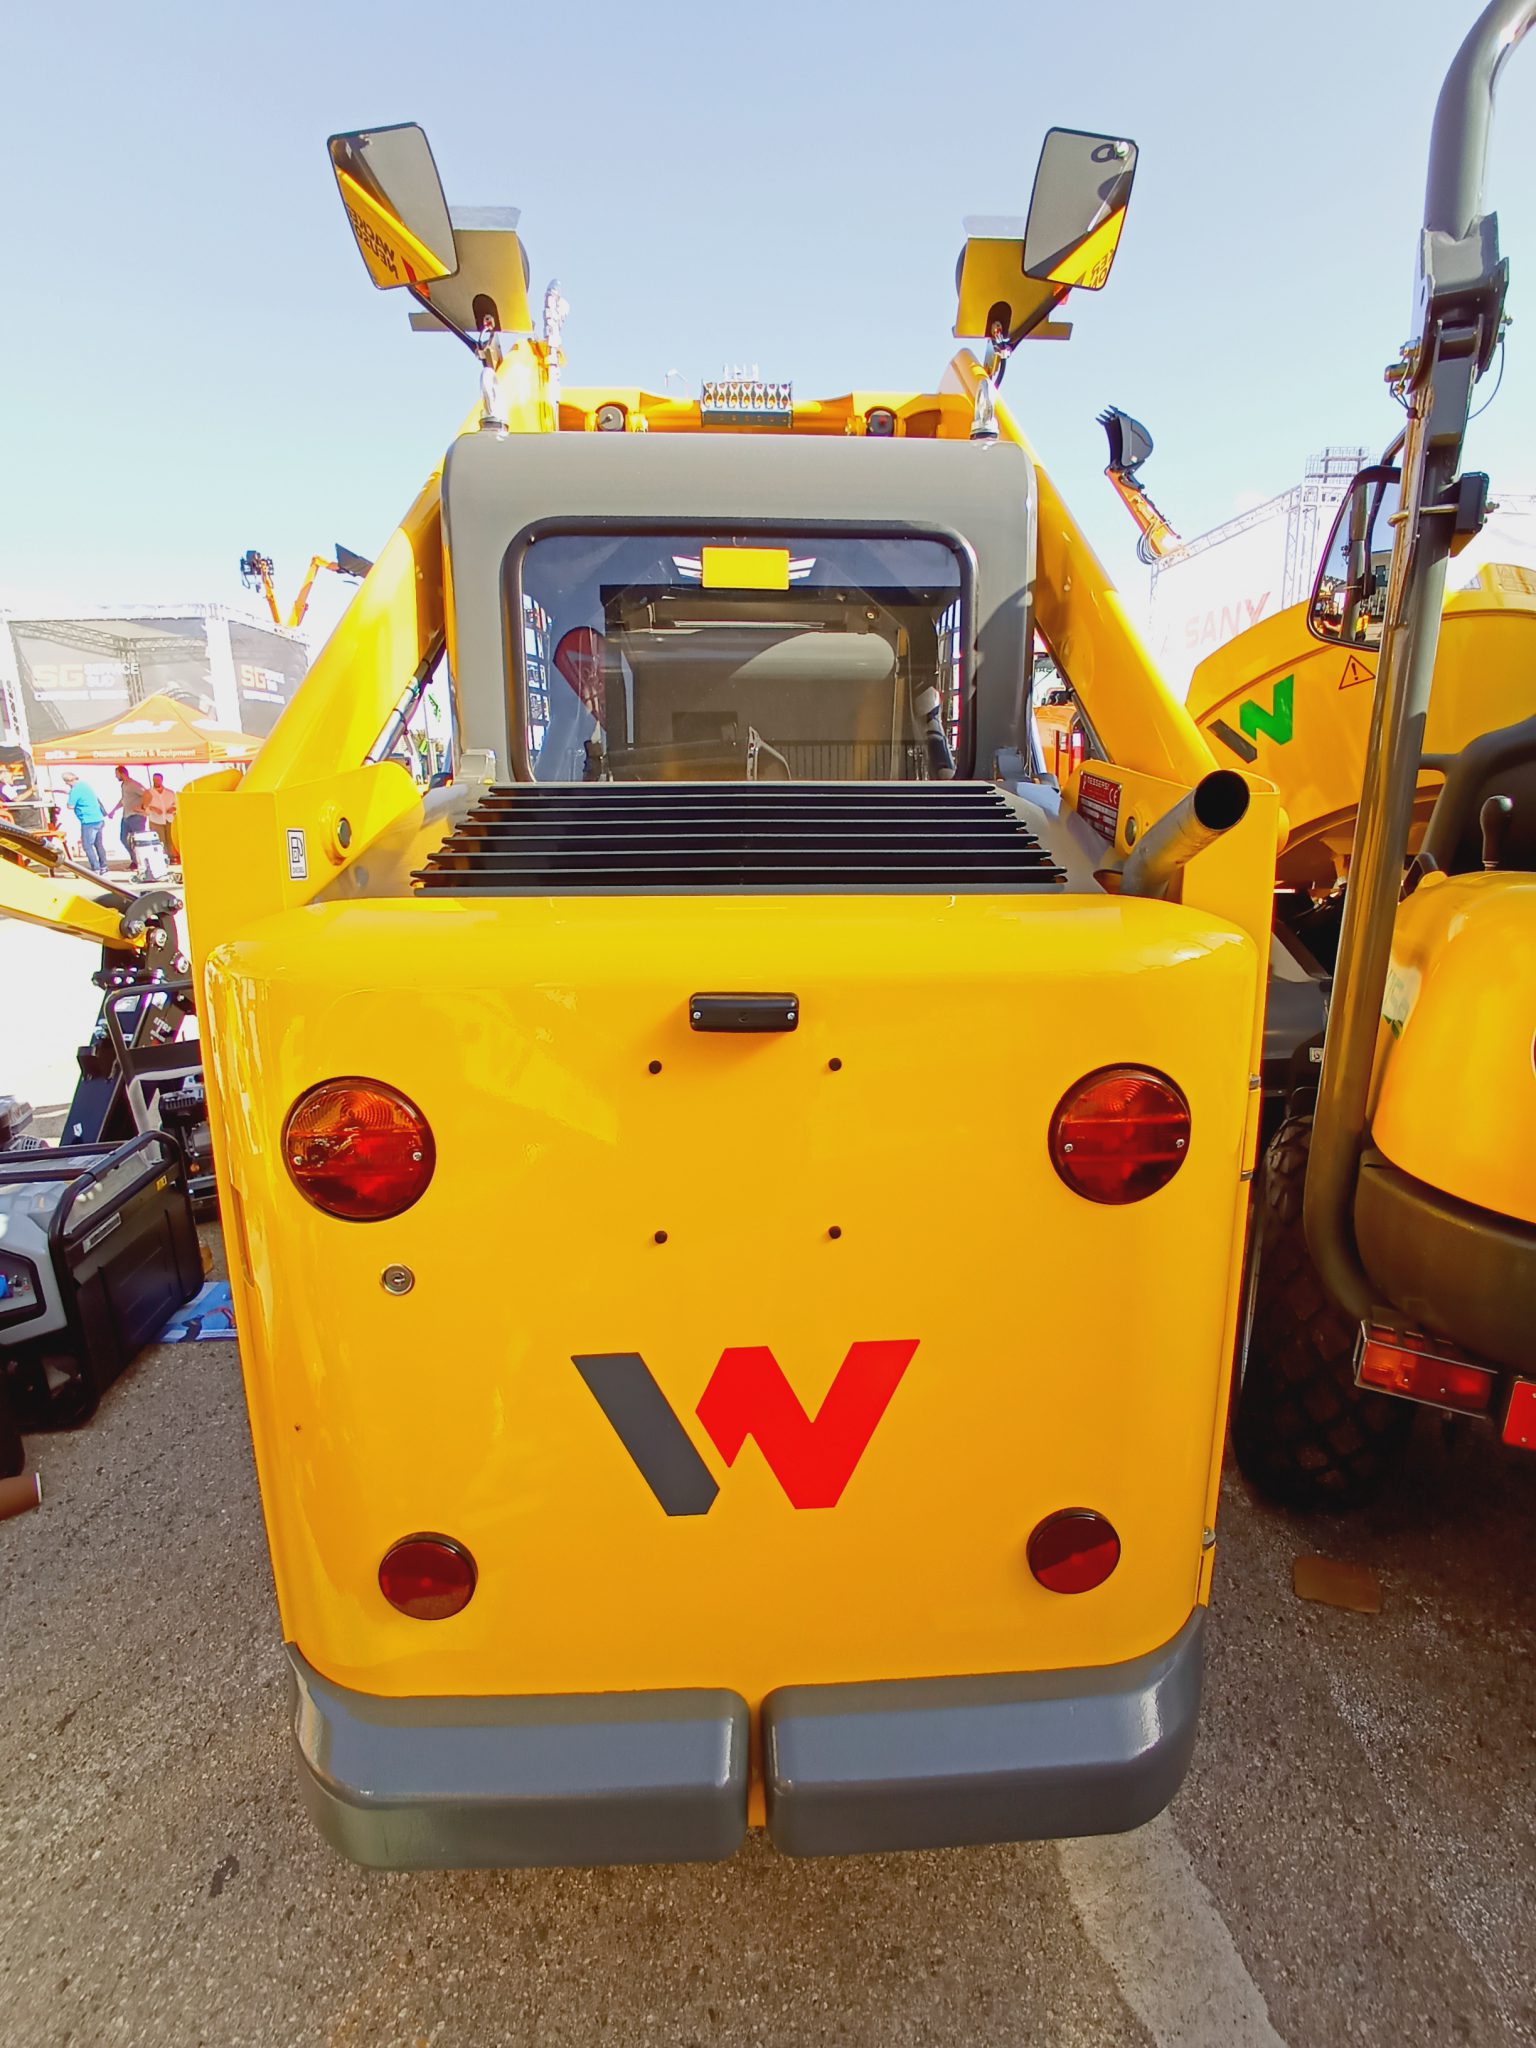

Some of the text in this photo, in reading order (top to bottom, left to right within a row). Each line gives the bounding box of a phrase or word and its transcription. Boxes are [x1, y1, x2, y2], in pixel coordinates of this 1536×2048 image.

[1184, 592, 1271, 650] SANY
[33, 664, 84, 688] SG
[84, 662, 140, 675] SVCE
[156, 748, 196, 759] Equipment
